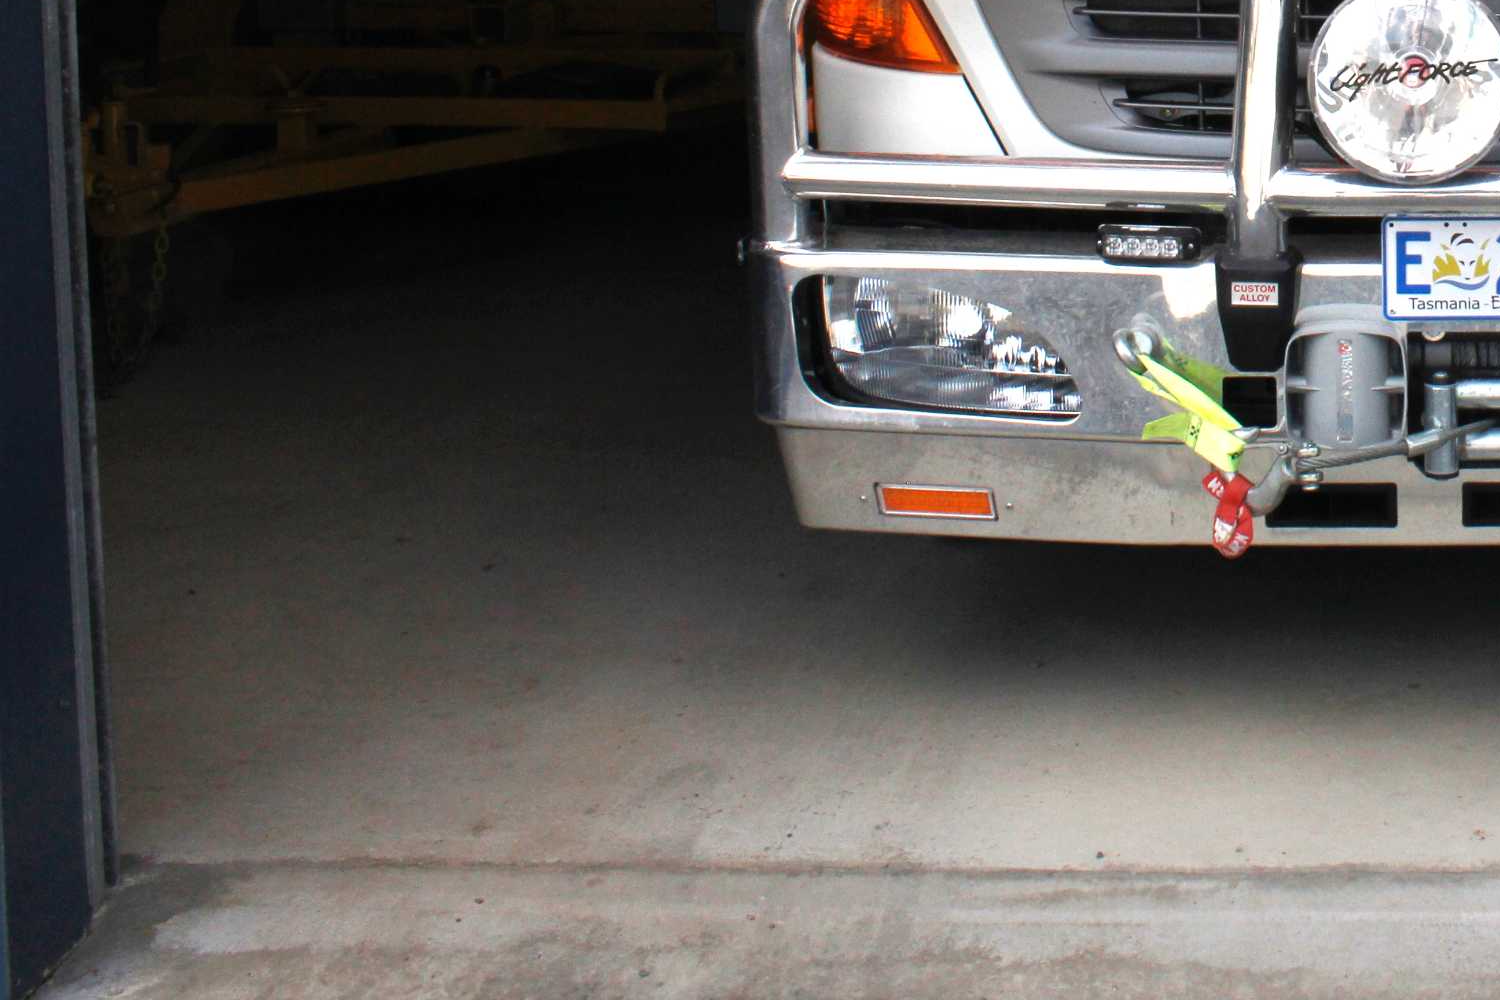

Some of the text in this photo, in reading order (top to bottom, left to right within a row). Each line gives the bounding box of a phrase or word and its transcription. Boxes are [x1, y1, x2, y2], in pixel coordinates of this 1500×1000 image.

[1396, 231, 1431, 295] E
[1233, 284, 1276, 293] CUSTOM
[1240, 294, 1270, 302] ALLOY
[1408, 297, 1480, 310] Tasmania
